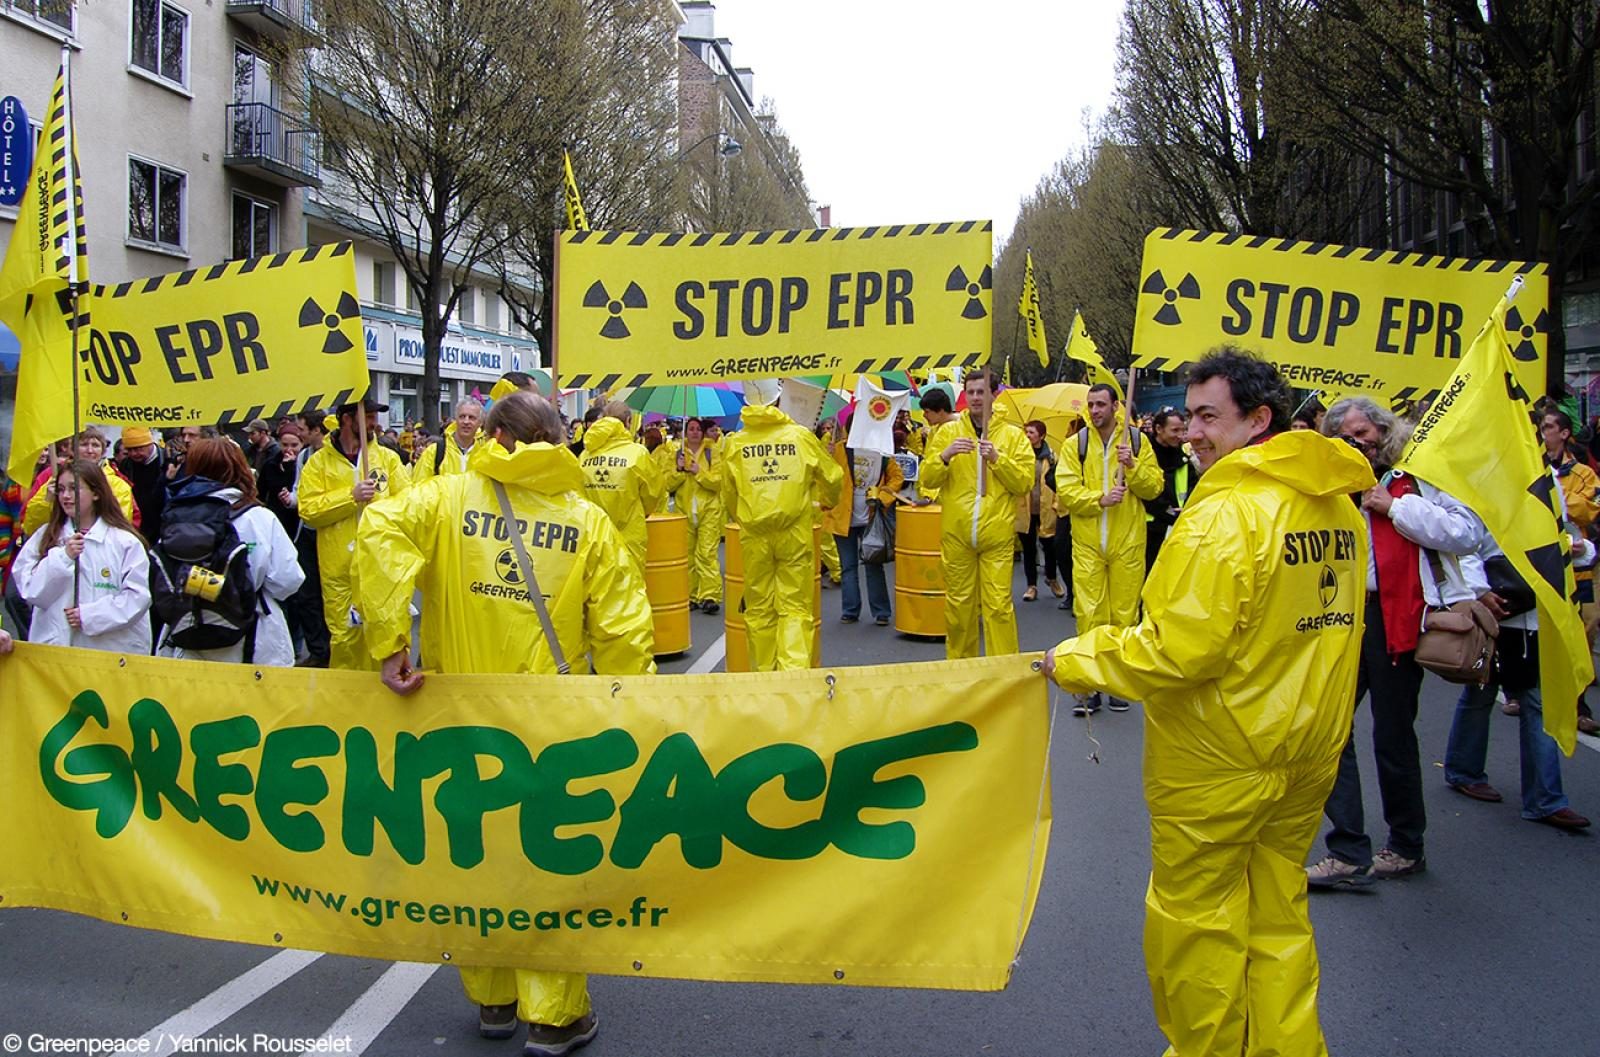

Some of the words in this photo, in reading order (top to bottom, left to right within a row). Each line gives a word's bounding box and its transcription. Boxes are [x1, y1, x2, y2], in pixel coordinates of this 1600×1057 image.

[2, 101, 15, 183] HÔTEL
[672, 277, 809, 341] STOP
[826, 268, 915, 330] EPR
[1221, 278, 1361, 348] STOP
[1375, 296, 1464, 359] EPR
[90, 328, 142, 386] OP
[154, 311, 270, 384] EPR
[399, 338, 427, 358] PROM
[440, 345, 459, 363] UEST
[461, 348, 501, 369] IMMOBILIER
[1271, 361, 1386, 390] REENPEACE.fr
[86, 402, 203, 423] .GREENPEACE.fr
[582, 455, 607, 468] STOP
[608, 456, 628, 467] EPR
[742, 444, 772, 459] STOP
[775, 443, 796, 456] EPR
[462, 509, 528, 543] STOP
[532, 521, 579, 553] EPR
[1284, 529, 1330, 566] STOP
[469, 581, 551, 603] GREENPEA
[40, 690, 979, 876] GREENPEACE
[252, 873, 669, 936] www.greenpeace.fr
